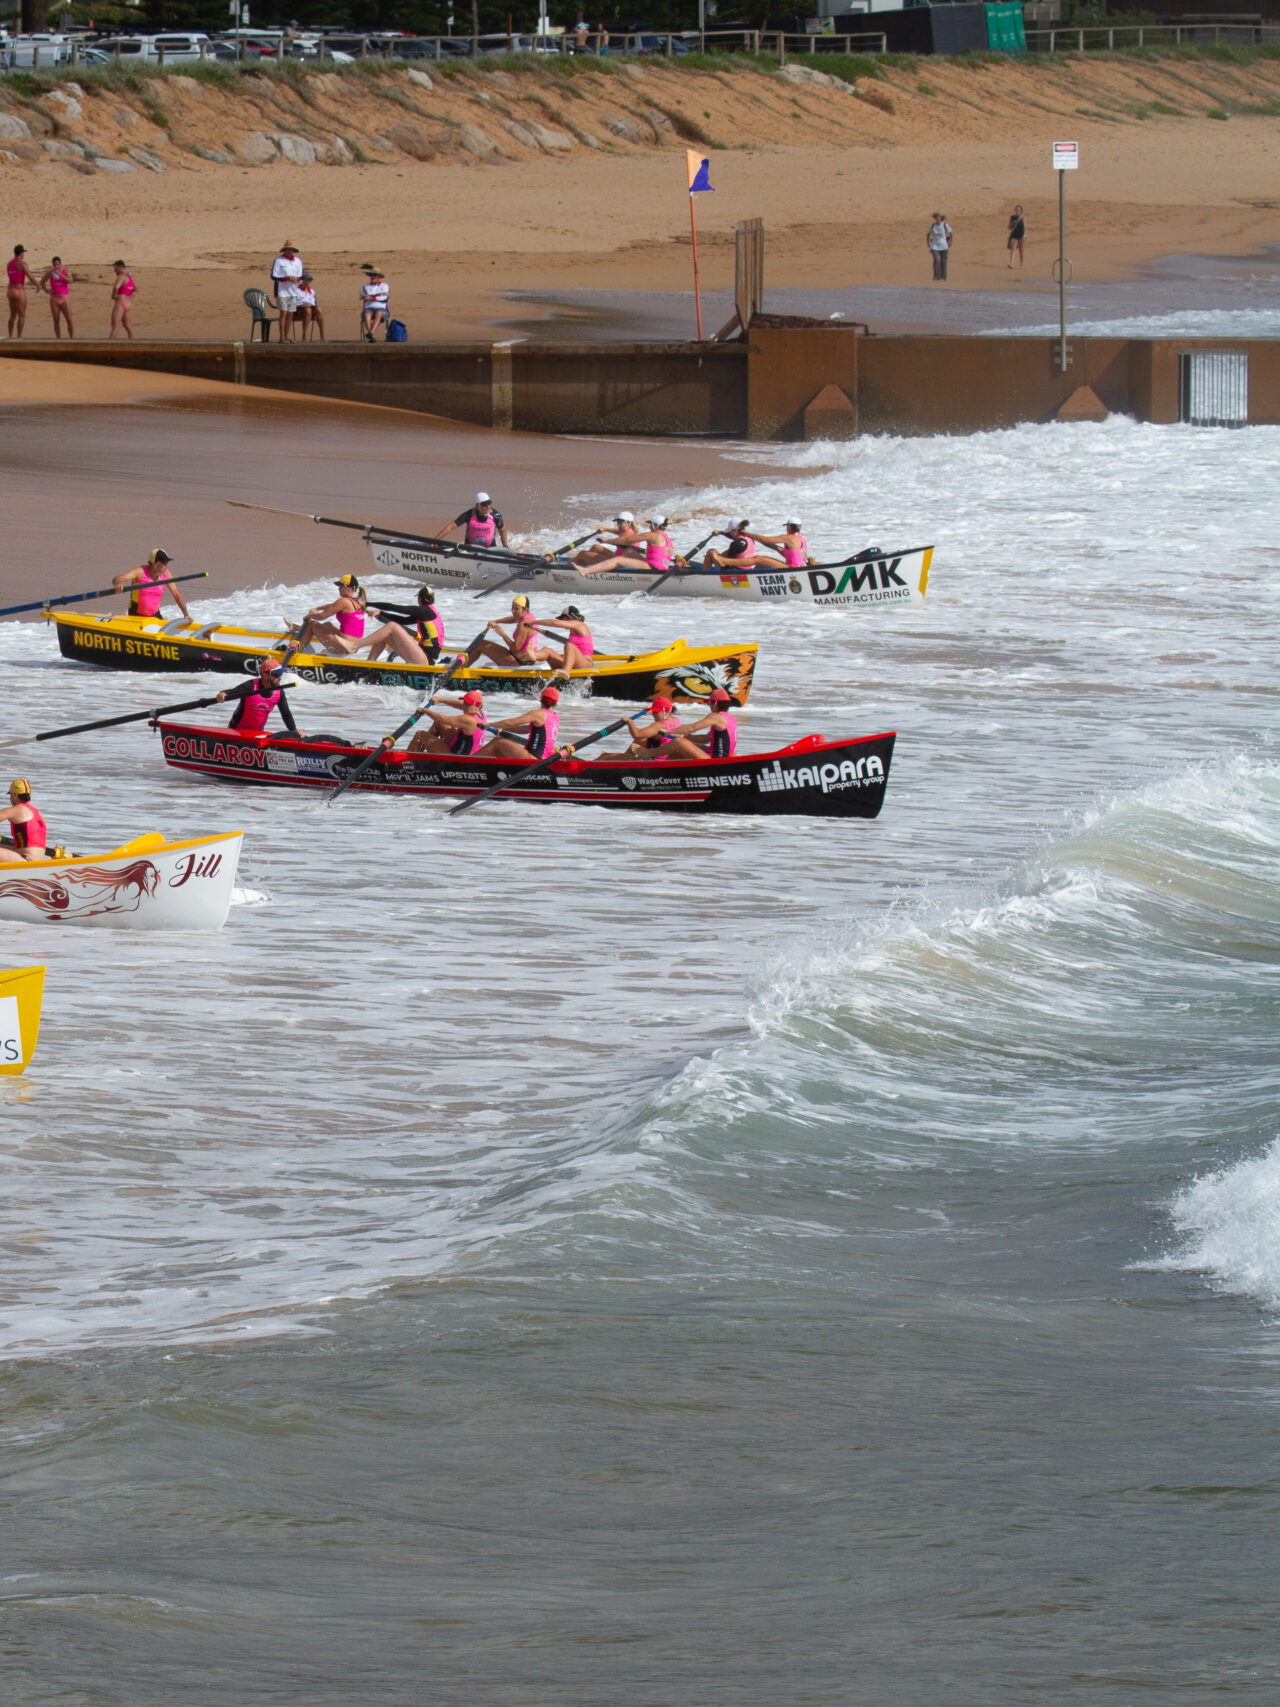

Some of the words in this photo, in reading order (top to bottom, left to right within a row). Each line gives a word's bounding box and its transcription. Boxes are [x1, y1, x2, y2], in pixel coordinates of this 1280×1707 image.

[401, 551, 438, 564] NORTH
[756, 575, 786, 585] TEAM
[808, 558, 908, 596] DMK
[760, 585, 787, 596] NAVY
[814, 588, 911, 605] MANUFACTURING
[73, 630, 121, 650] NORTH
[125, 639, 181, 661] STEYNE
[163, 736, 266, 768] COLLAROY
[295, 756, 327, 769] REILLY
[441, 771, 488, 781] UPSTATE
[637, 776, 681, 787] WageCover
[828, 779, 861, 793] property
[863, 775, 885, 787] group
[168, 853, 222, 888] Jill
